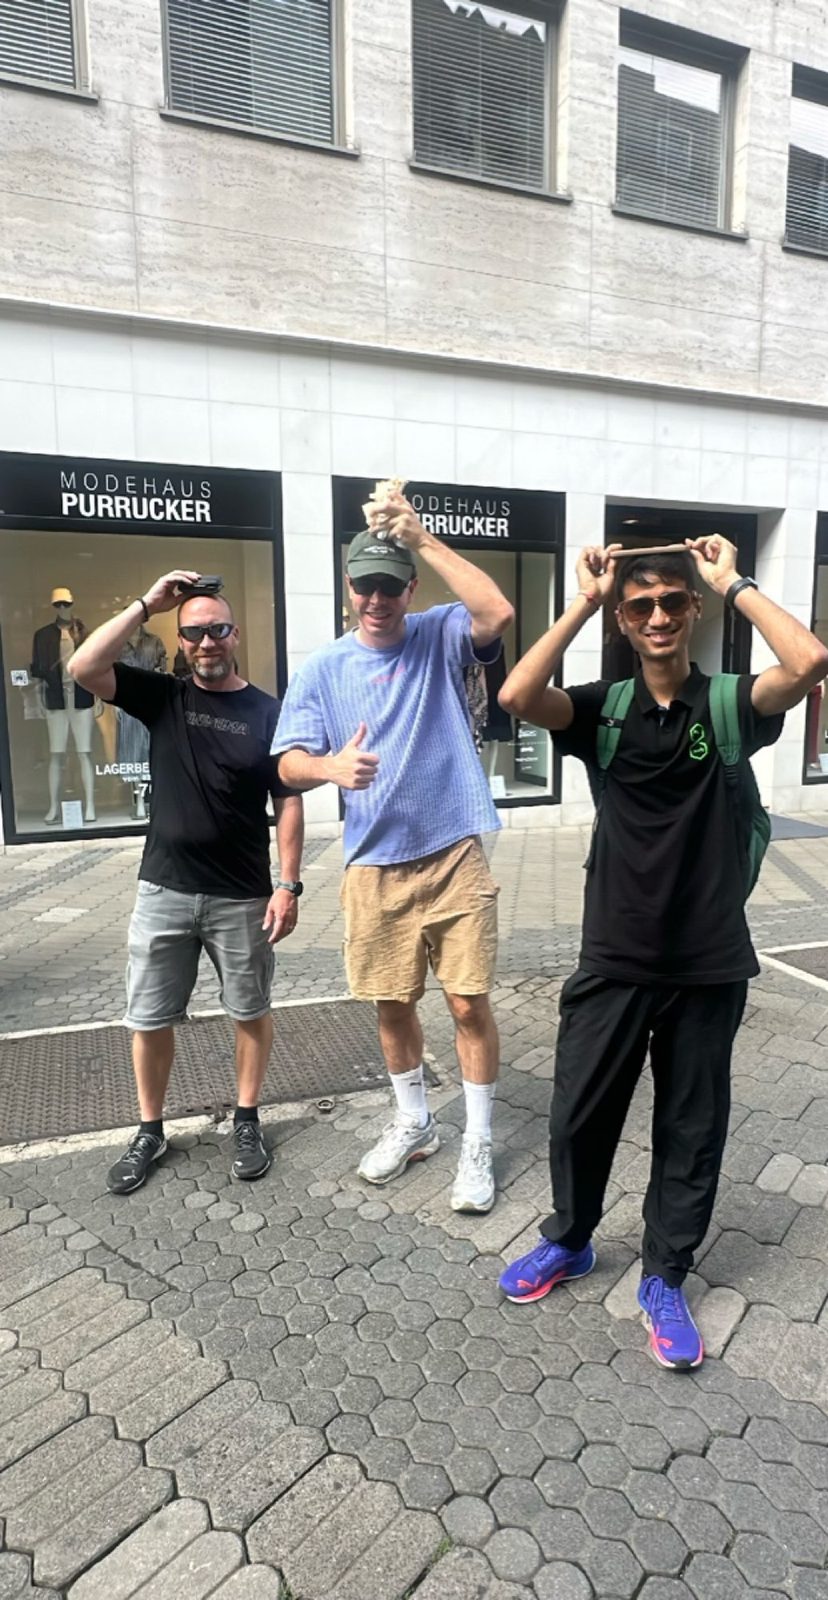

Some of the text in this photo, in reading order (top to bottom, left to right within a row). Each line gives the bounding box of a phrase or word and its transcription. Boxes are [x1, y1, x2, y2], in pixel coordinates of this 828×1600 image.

[60, 471, 212, 499] MODEHAUS
[61, 492, 212, 523] PURRUCKER
[411, 494, 511, 516] ODEHAUS
[416, 513, 510, 538] RRUCKER
[95, 762, 150, 775] LAGERBE
[133, 783, 152, 798] -7
